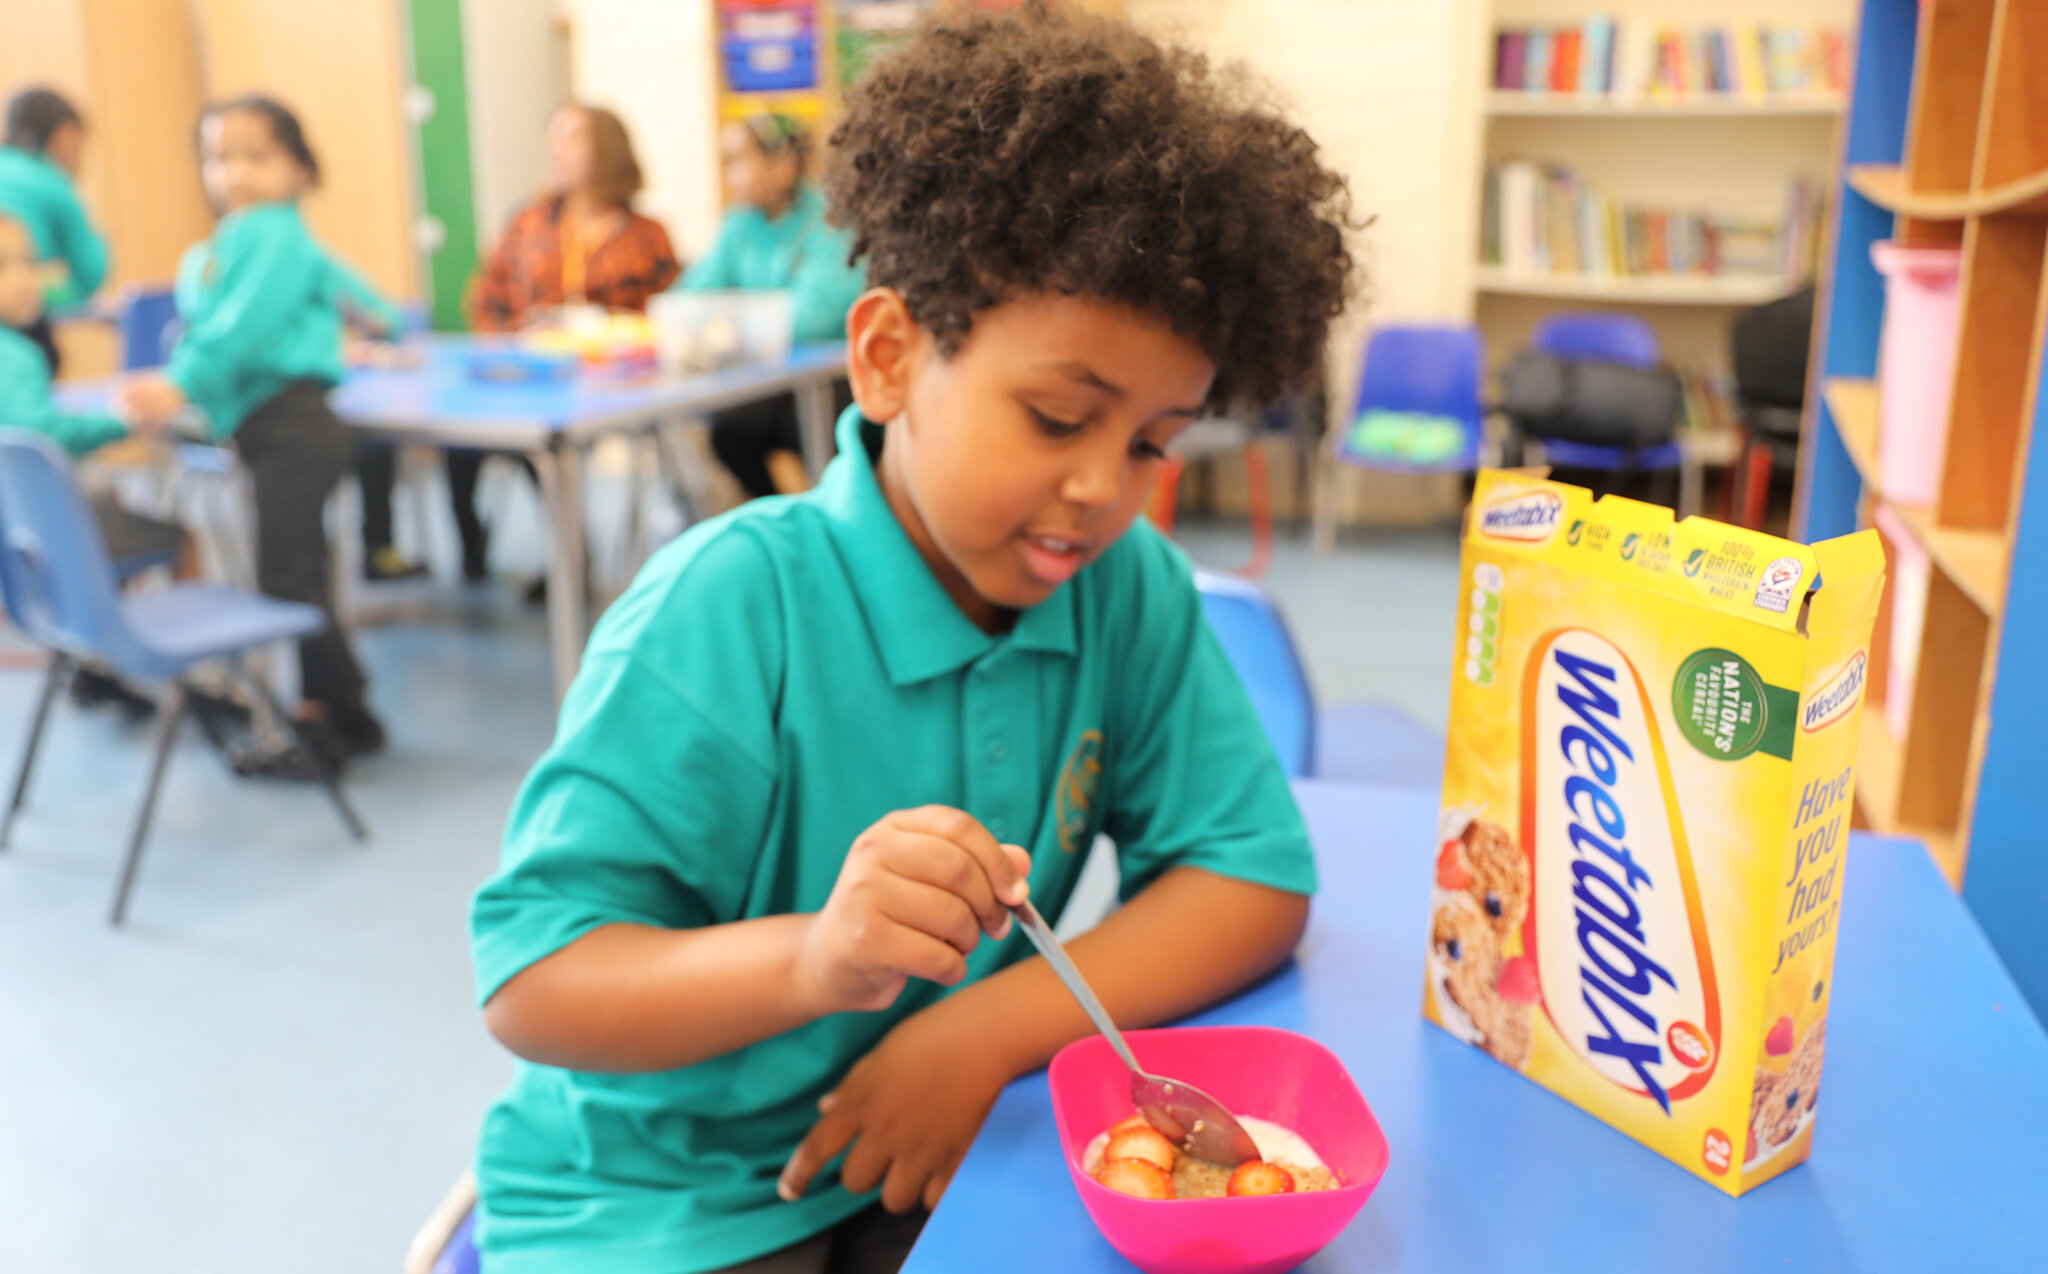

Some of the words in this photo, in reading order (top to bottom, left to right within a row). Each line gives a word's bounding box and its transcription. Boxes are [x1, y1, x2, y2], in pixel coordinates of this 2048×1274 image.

[1484, 502, 1561, 530] Weetabix
[1721, 541, 1755, 560] 100%
[1706, 554, 1757, 579] BRITISH
[1702, 665, 1723, 738] FAVOURITE
[1714, 661, 1741, 753] NATION'S
[1740, 701, 1753, 726] THE
[1804, 655, 1867, 727] Weetabix
[1793, 765, 1852, 830] Have
[1554, 648, 1680, 1118] Weetabix
[1786, 813, 1843, 888] you
[1787, 852, 1840, 926] had
[1771, 900, 1838, 976] yours?
